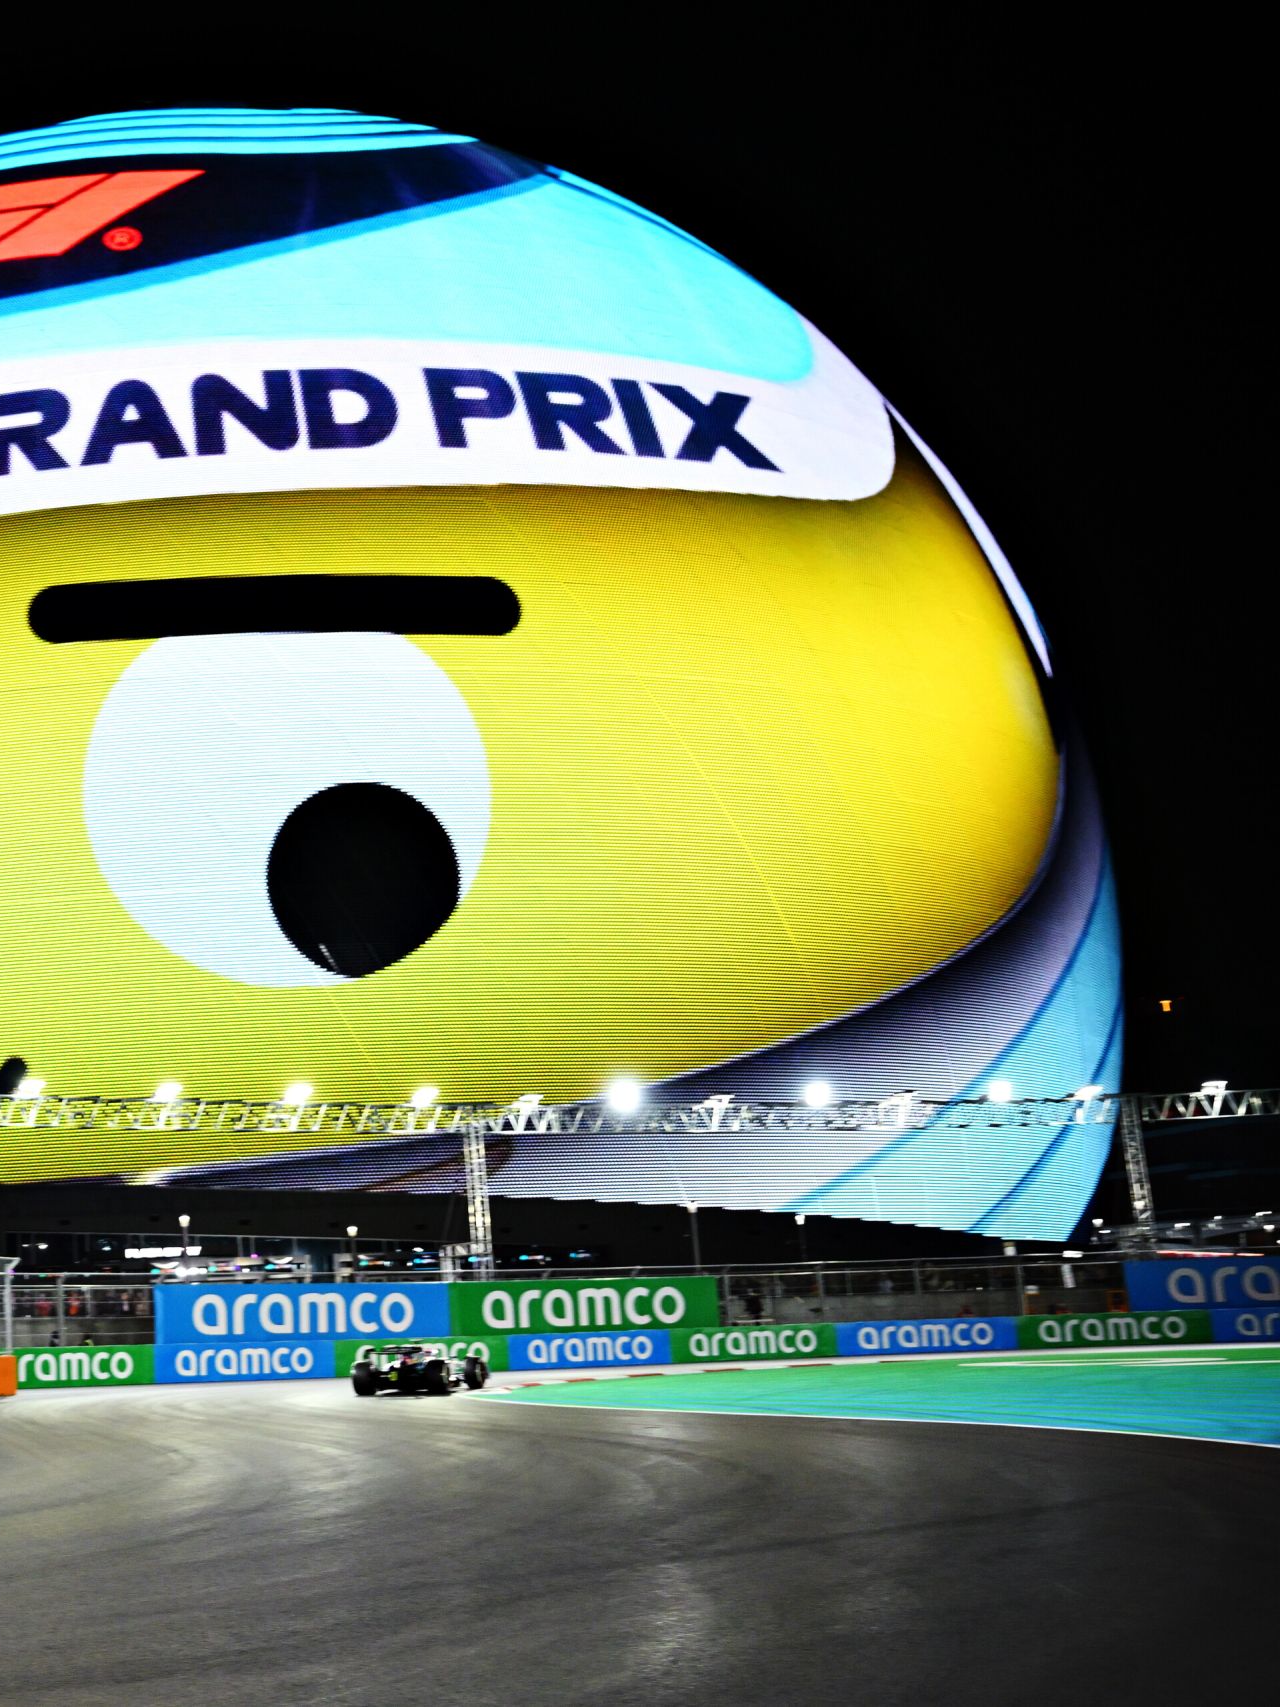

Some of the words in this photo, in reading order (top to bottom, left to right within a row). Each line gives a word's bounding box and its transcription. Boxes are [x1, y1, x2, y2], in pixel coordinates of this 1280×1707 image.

[422, 367, 783, 473] PRIX
[192, 1292, 415, 1336] aramco
[482, 1286, 686, 1329] aramco
[689, 1329, 818, 1357] aramco
[857, 1322, 993, 1350] aramco
[1038, 1314, 1188, 1343] aramco
[175, 1346, 314, 1377] aramco
[527, 1335, 653, 1364] aramco
